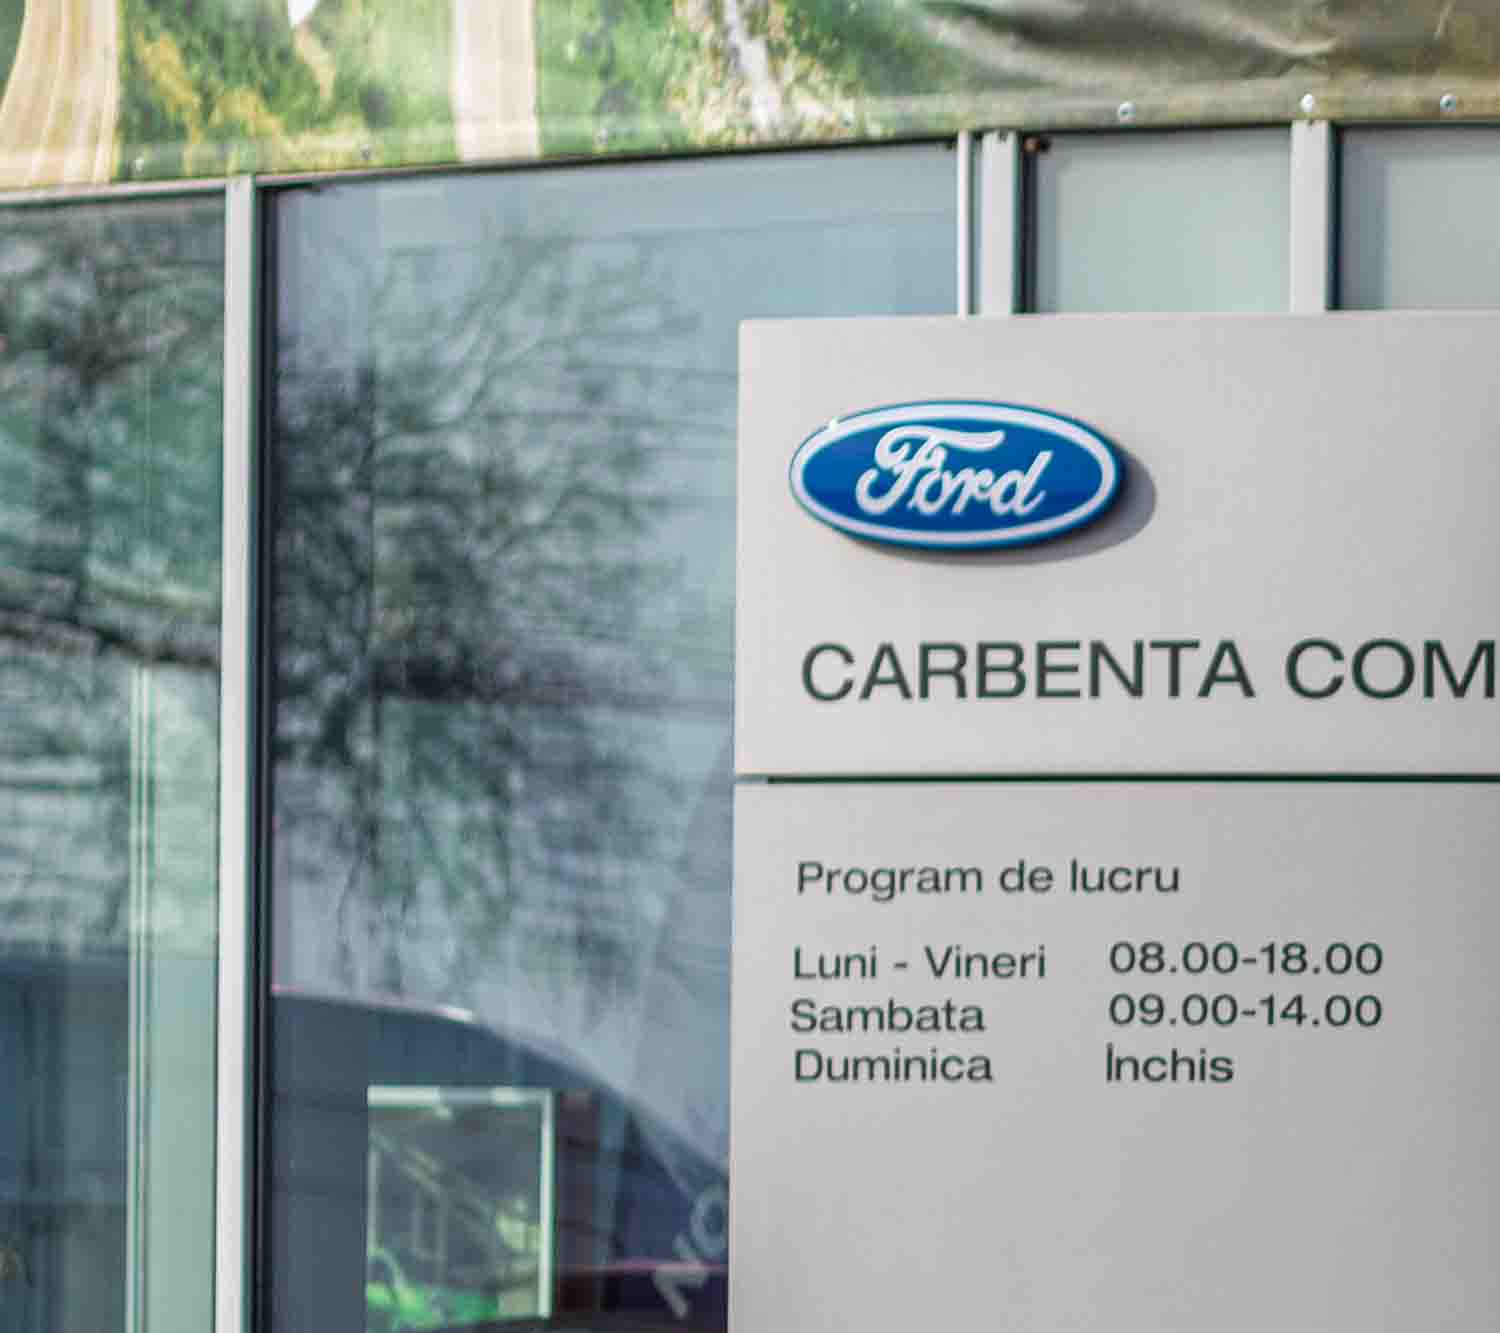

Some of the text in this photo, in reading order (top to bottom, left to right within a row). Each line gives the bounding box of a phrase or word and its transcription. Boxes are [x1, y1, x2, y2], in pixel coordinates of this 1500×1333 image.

[855, 426, 1051, 516] Ford
[801, 637, 1498, 702] CARBENTA COM
[798, 858, 1180, 903] Program de lucru
[794, 945, 877, 979] Luni
[924, 944, 1046, 979] Vineri
[1109, 941, 1383, 975] 08.00-18.00
[791, 997, 985, 1033] Sambata
[1108, 993, 1382, 1027] 09.00-14.00
[794, 1046, 993, 1083] Duminica
